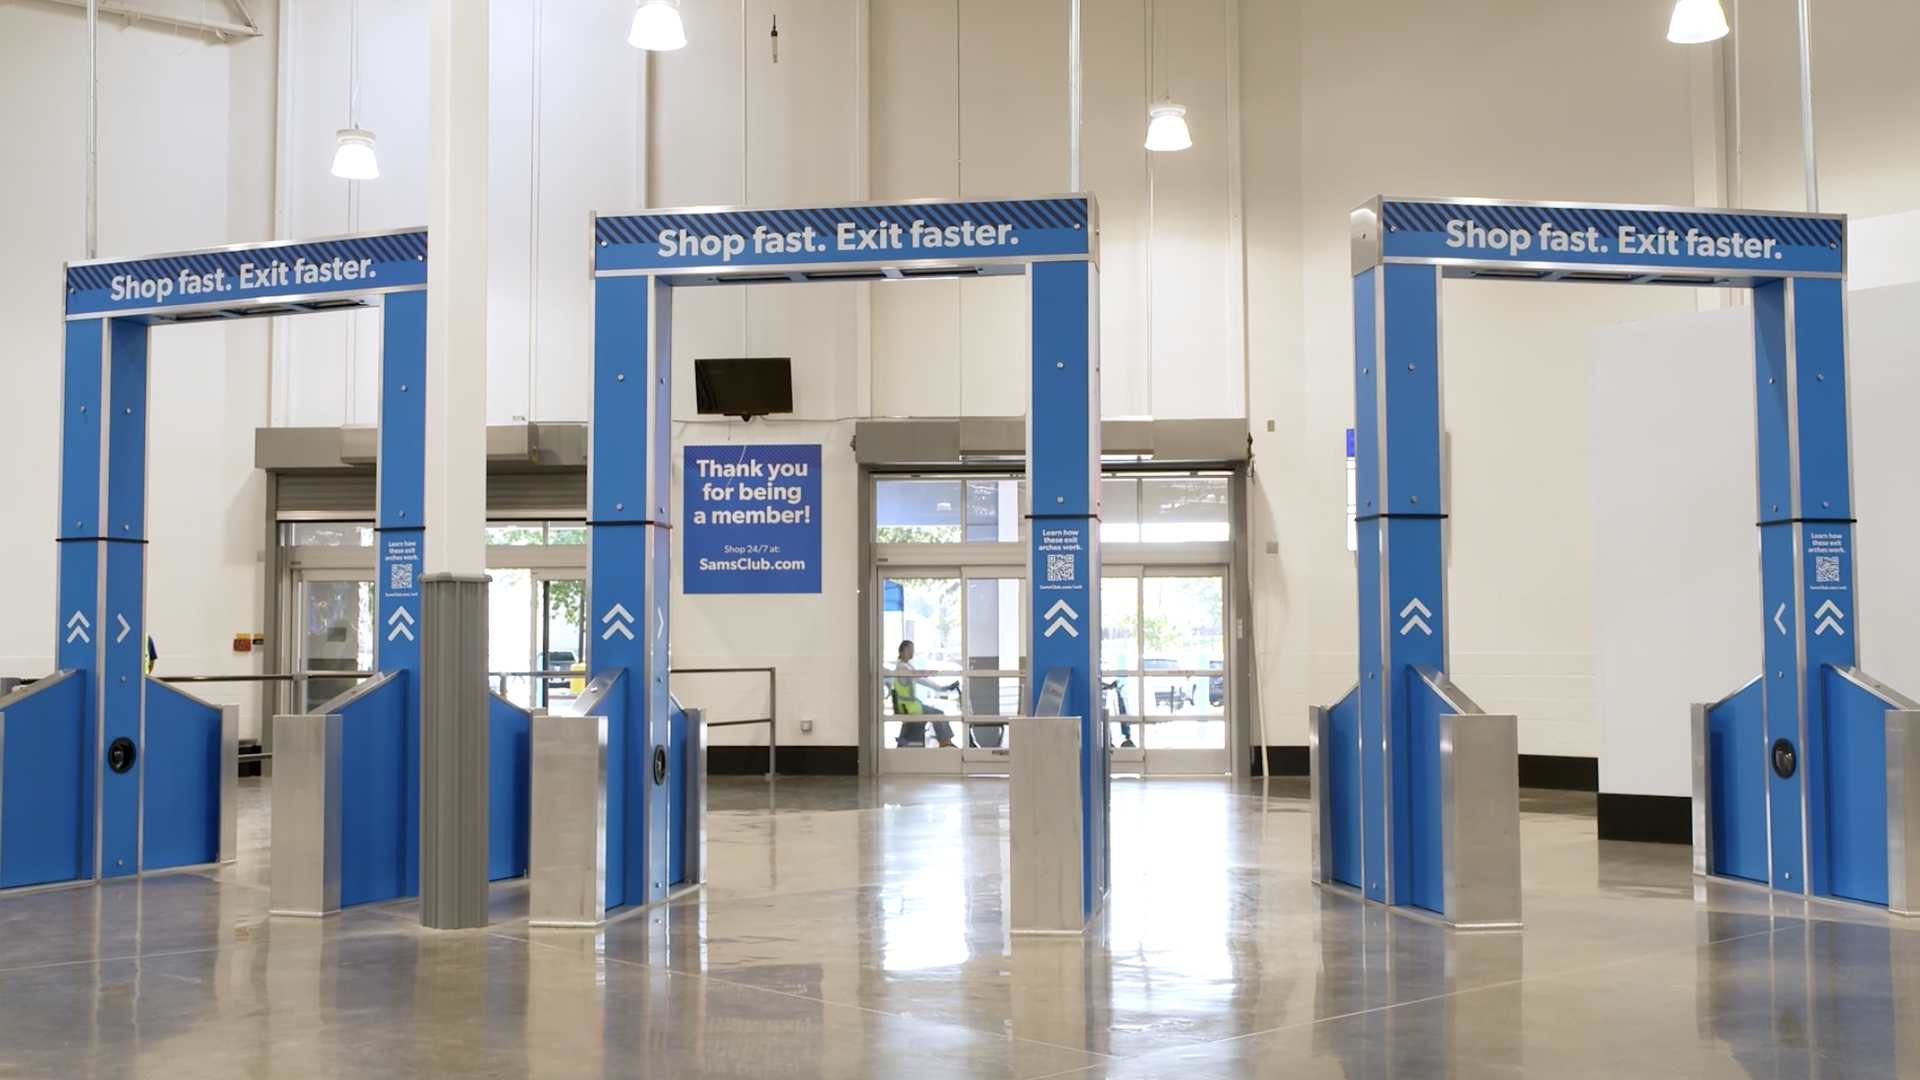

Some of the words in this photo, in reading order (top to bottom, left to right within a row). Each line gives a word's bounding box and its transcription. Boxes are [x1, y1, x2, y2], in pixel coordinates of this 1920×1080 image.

[657, 228, 745, 262] Shop
[752, 225, 826, 254] fast.
[836, 220, 902, 251] Exit
[909, 219, 1019, 249] faster.
[1445, 219, 1531, 256] Shop
[1538, 222, 1609, 253] fast.
[1617, 225, 1679, 256] Exit
[1685, 228, 1783, 260] faster.
[110, 274, 173, 303] Shop
[178, 268, 232, 295] fast.
[239, 260, 289, 290] Exit
[294, 257, 377, 285] faster.
[696, 459, 764, 478] Thank
[767, 462, 808, 481] you
[702, 482, 735, 501] for
[739, 482, 802, 504] being
[693, 510, 706, 524] a
[711, 505, 811, 524] member!
[724, 545, 745, 554] Shop
[747, 544, 769, 553] 24/7
[769, 545, 781, 553] at:
[1062, 543, 1083, 551] work.
[699, 558, 806, 570] SamsClub.com
